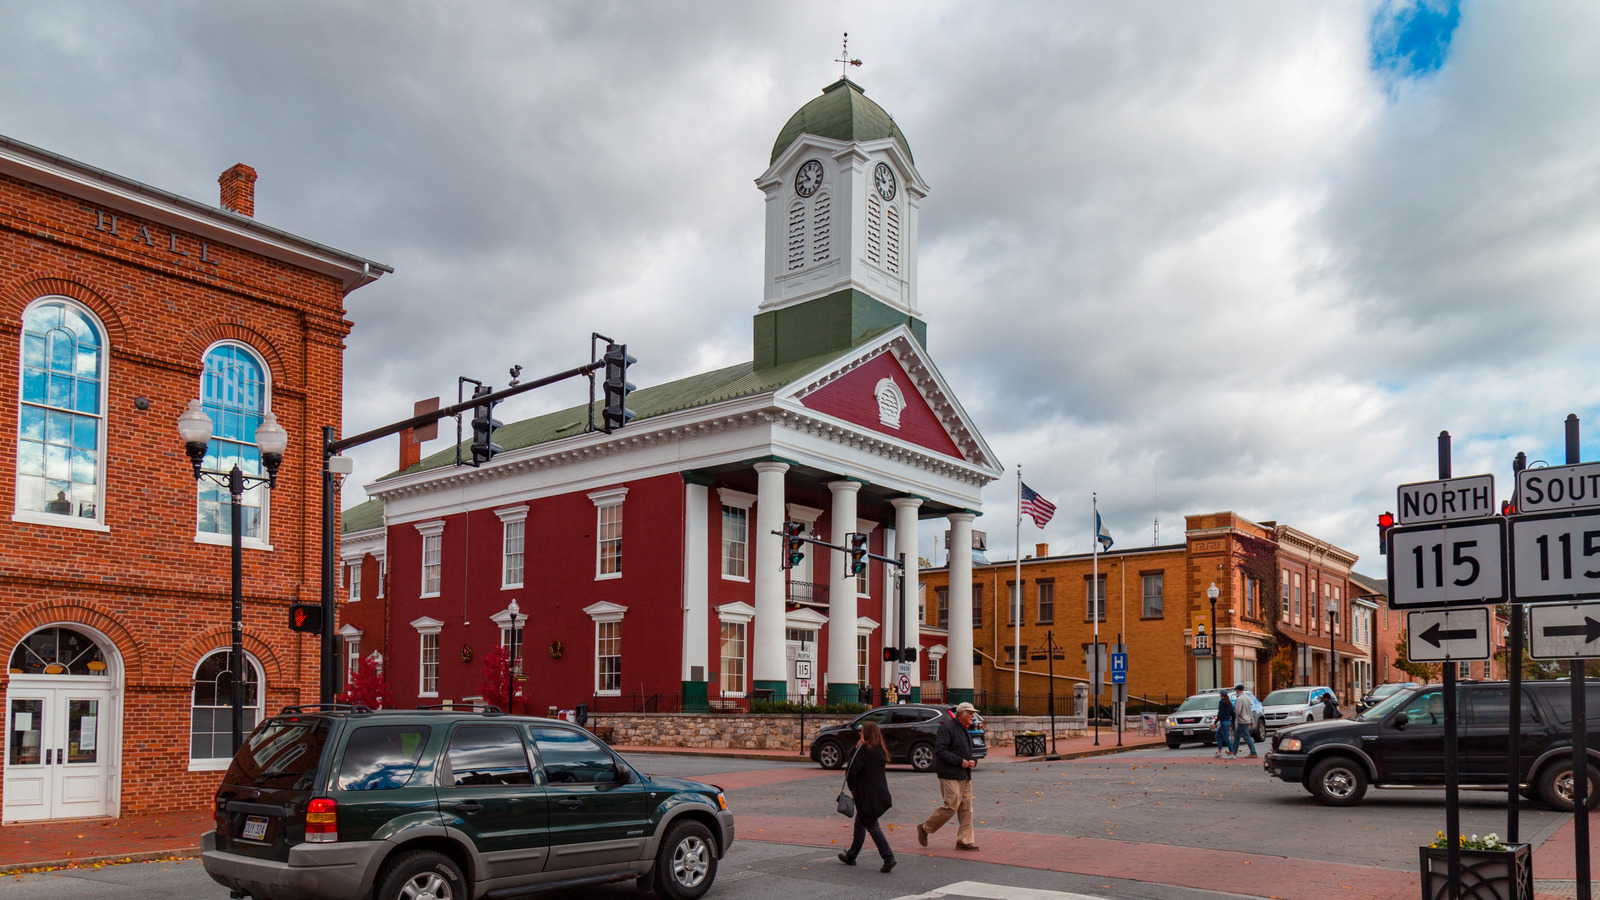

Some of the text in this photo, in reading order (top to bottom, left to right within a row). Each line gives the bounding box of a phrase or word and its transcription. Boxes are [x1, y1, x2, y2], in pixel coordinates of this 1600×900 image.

[94, 210, 219, 266] HALL
[1403, 486, 1488, 518] NORTH
[1412, 540, 1480, 589] 115
[1536, 530, 1600, 581] 115
[798, 664, 809, 676] 115
[1114, 655, 1124, 669] H
